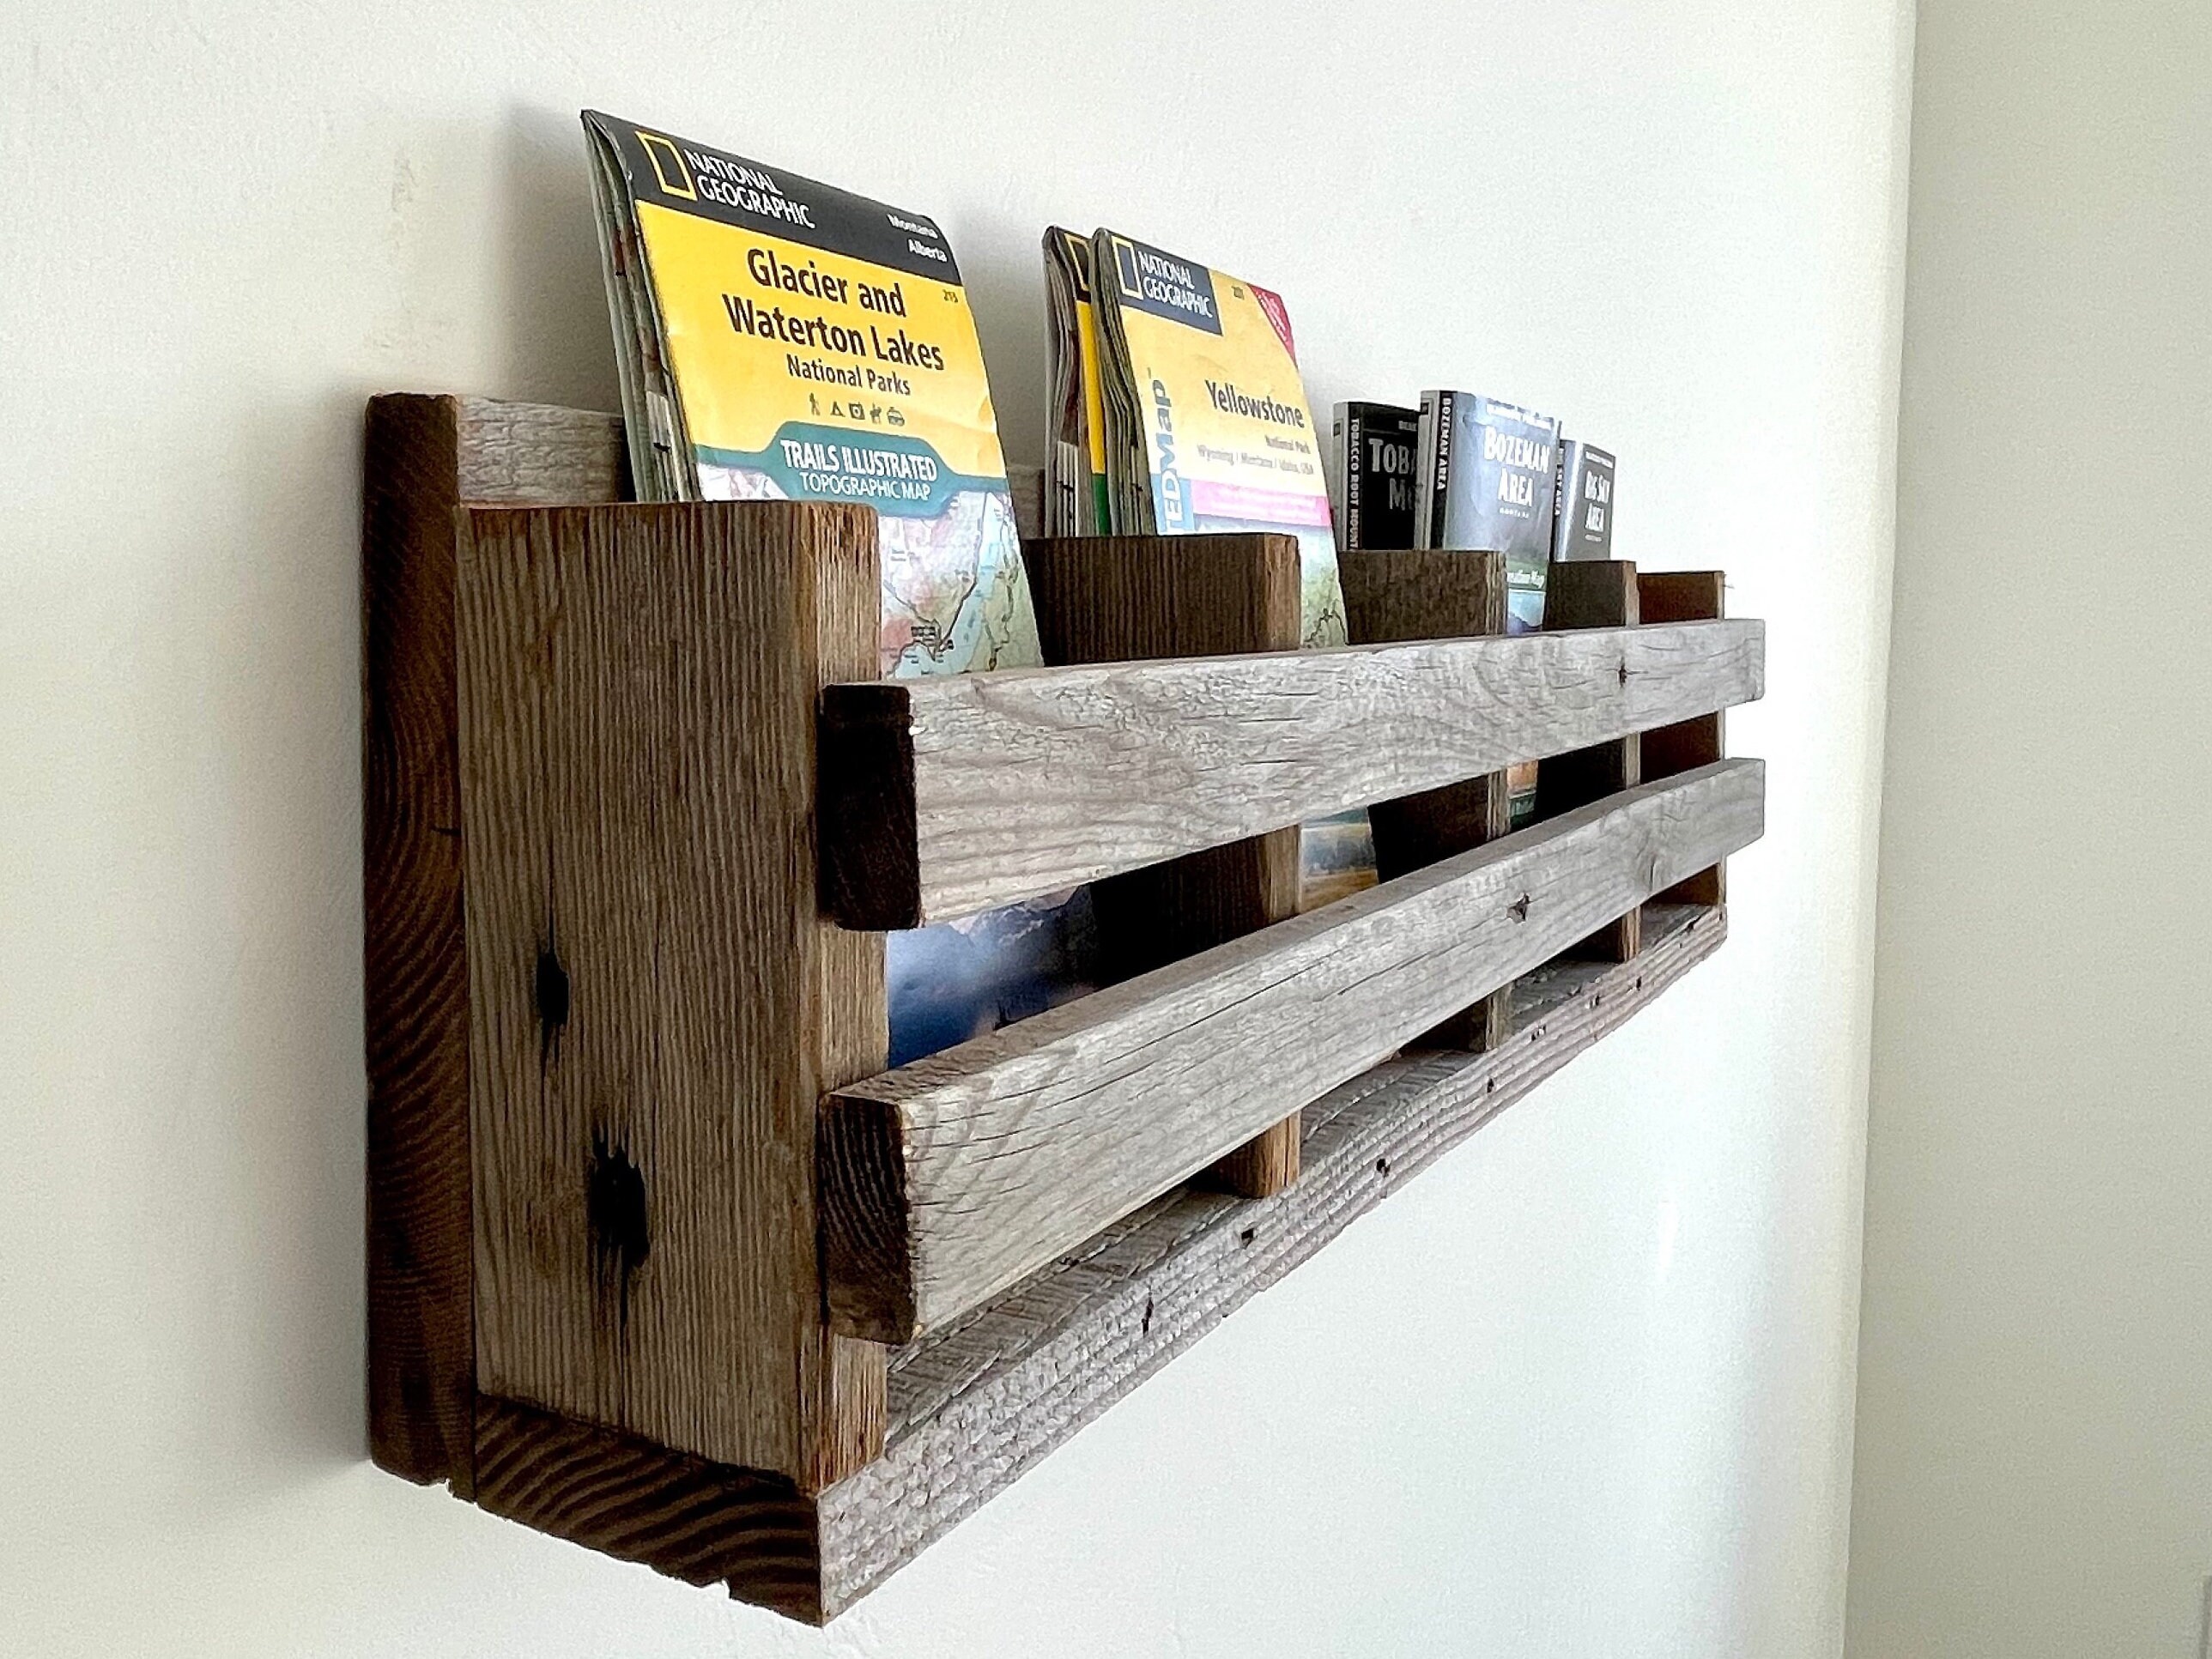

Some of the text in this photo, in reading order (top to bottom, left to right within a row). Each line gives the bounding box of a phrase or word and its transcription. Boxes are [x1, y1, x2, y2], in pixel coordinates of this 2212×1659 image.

[683, 148, 783, 196] NATIONAL
[697, 175, 815, 229] GEOGRAPHIC
[907, 239, 948, 263] Alberta
[1137, 251, 1195, 289] NATIONAL
[747, 248, 906, 318] Glacier and
[1142, 276, 1213, 318] GEOGRAPHIC
[722, 294, 944, 371] Waterton Lakes
[786, 354, 911, 396] National Parks
[1204, 378, 1305, 428] Yellowstone
[780, 439, 937, 482] TRAILS ILLUSTRATED
[1437, 397, 1451, 490] BOZEMAN AREA
[1483, 425, 1550, 474] BOZEMAN
[799, 472, 931, 502] TOPOGRAPHIC MAP
[1349, 418, 1360, 549] TOBACCO ROOT MOUNT
[1498, 467, 1533, 506] AREA
